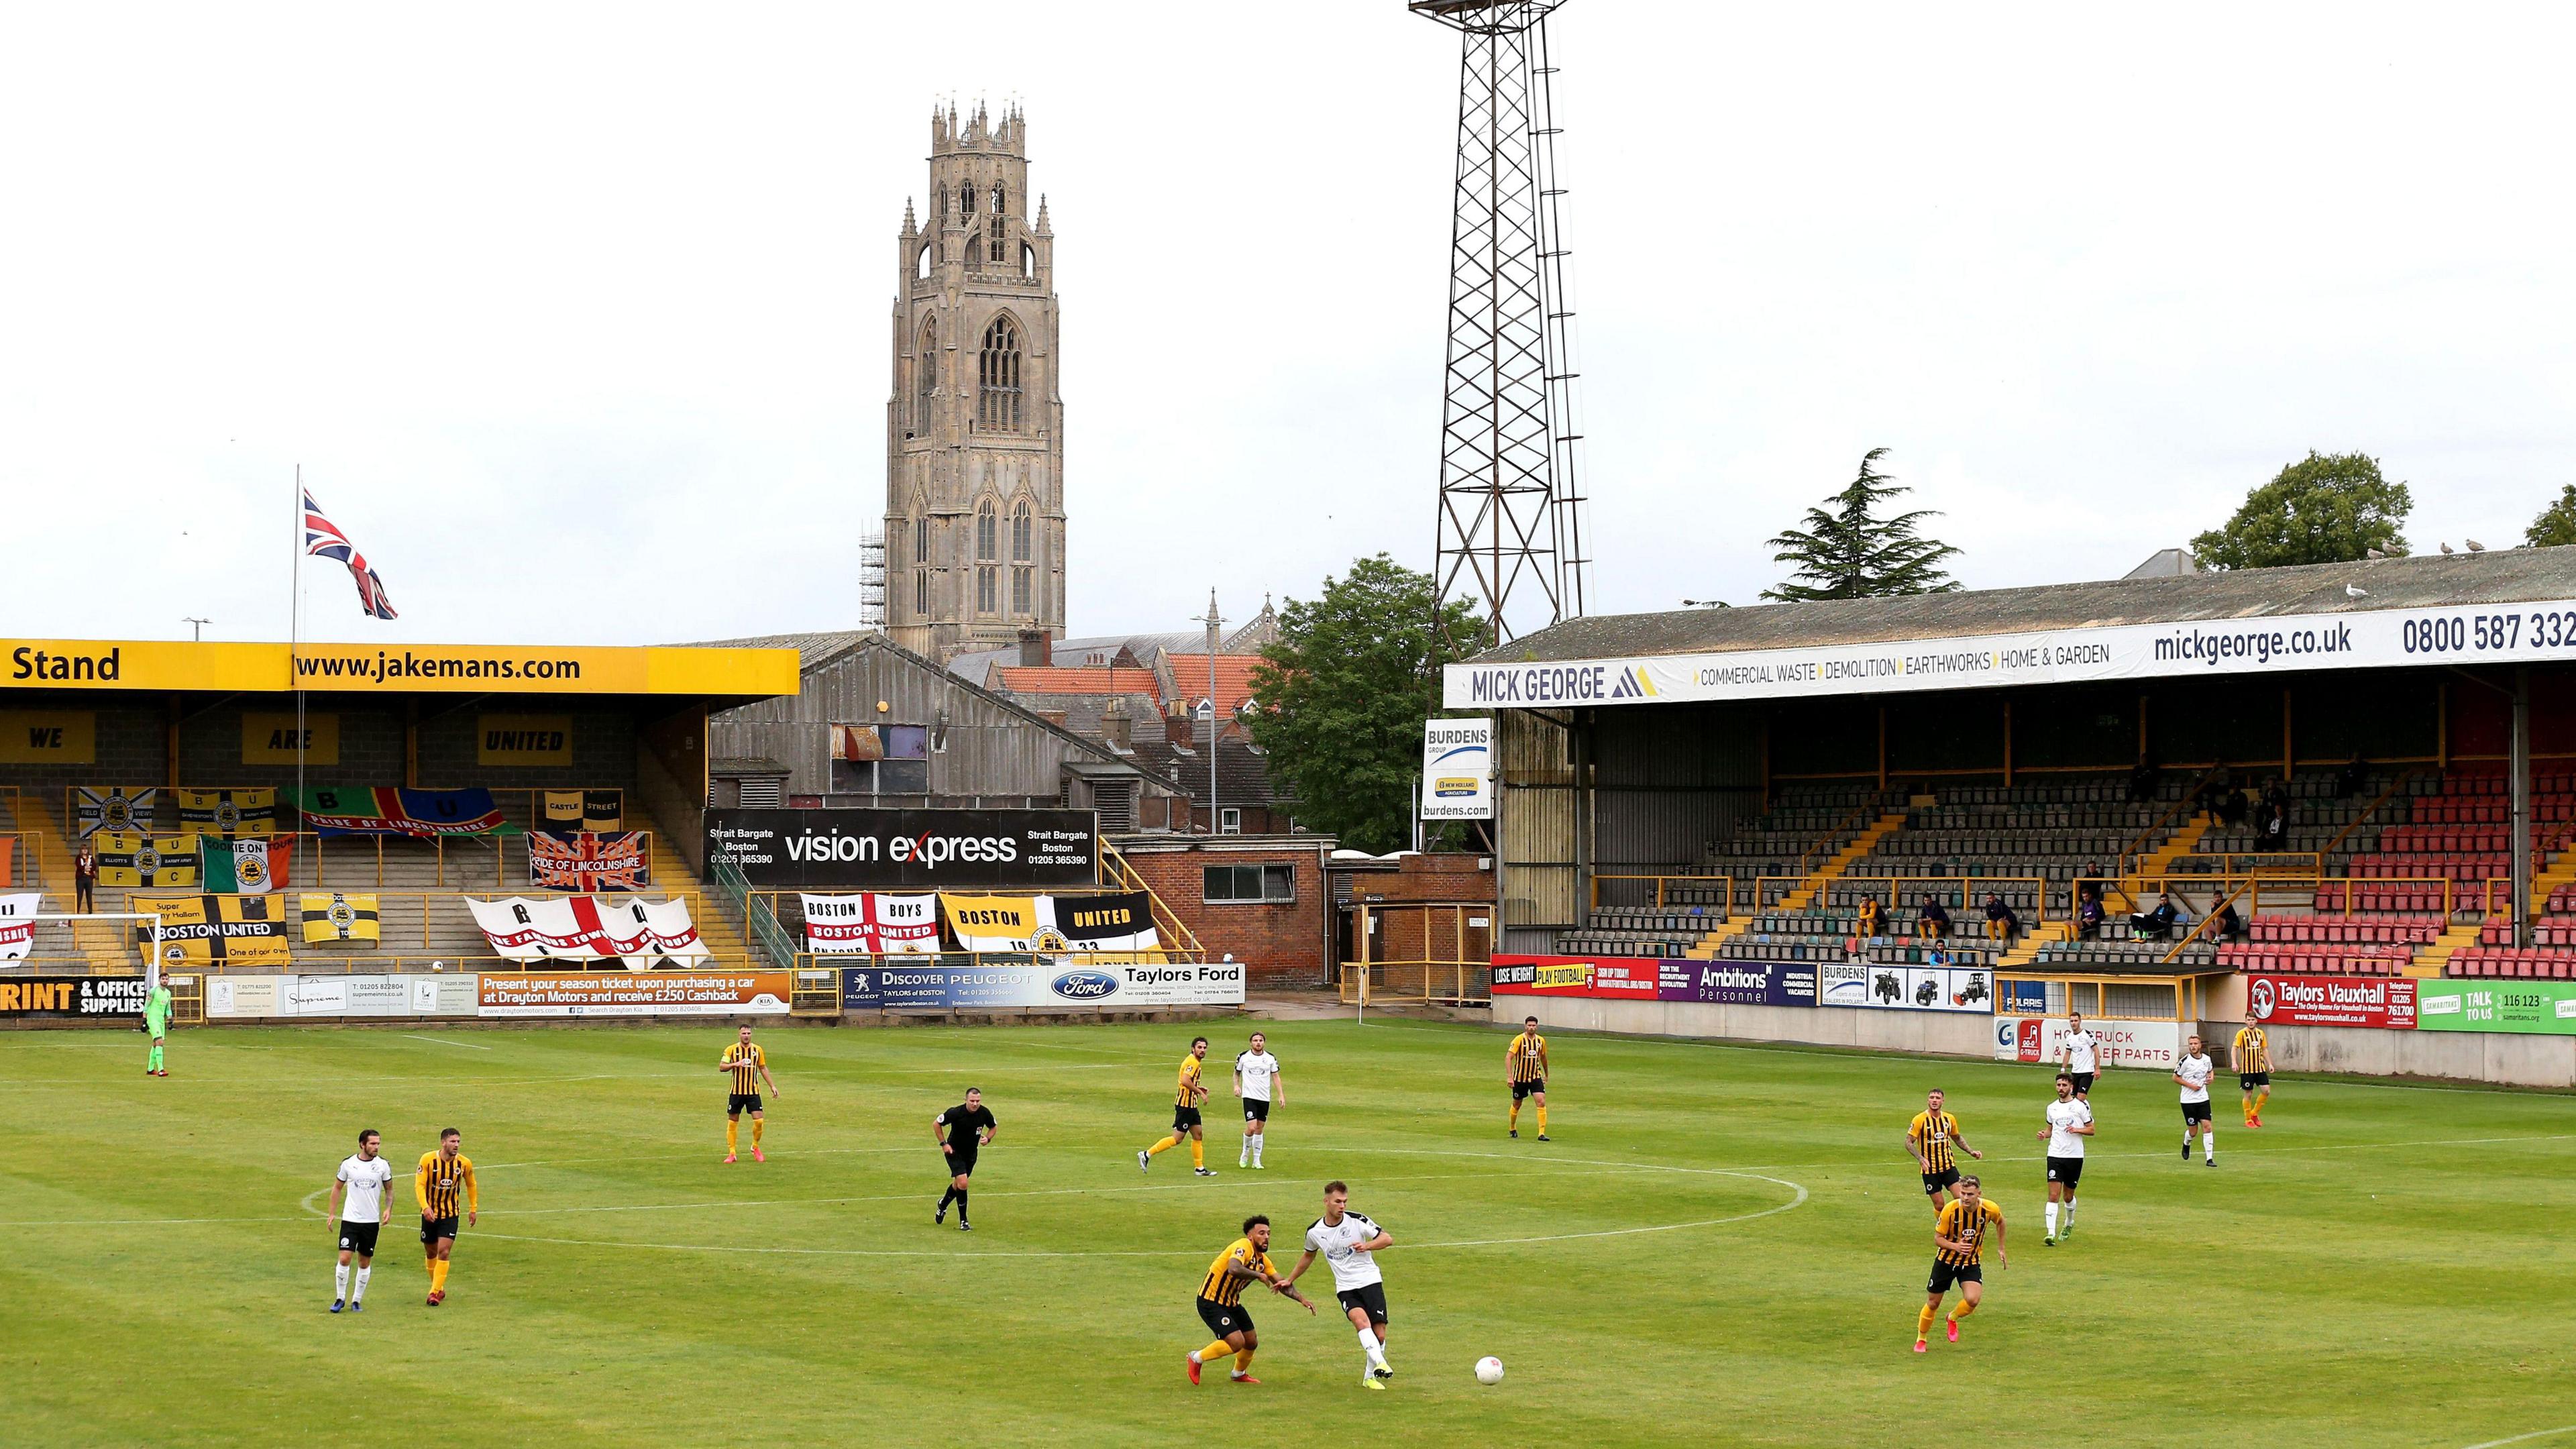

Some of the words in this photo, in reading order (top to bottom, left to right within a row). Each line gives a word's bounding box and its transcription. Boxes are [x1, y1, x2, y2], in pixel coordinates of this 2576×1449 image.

[2404, 616, 2465, 653] 0800
[2475, 614, 2520, 650] 587
[2155, 621, 2351, 665] mickgeorge.co.uk
[12, 647, 119, 681] Stand
[296, 651, 580, 683] www.jakemans.com
[1701, 665, 1774, 686] COMMERCIAL
[1776, 663, 1816, 682] WASTE
[1825, 657, 1896, 680] DEMOLITION
[1906, 651, 1991, 675] EARTHWORKS
[2001, 649, 2037, 669] HOME
[2042, 647, 2051, 665] &
[2056, 644, 2110, 665] GARDEN
[1472, 670, 1520, 701] MICK
[1525, 667, 1605, 701] GEORGE
[30, 728, 63, 748] WE
[268, 729, 312, 749] ARE
[486, 731, 564, 751] UNITED
[1428, 730, 1487, 744] BURDENS
[316, 792, 339, 809] B
[549, 802, 578, 810] CASTLE
[587, 802, 617, 810] STREET
[1424, 805, 1488, 815] burdens.com
[310, 814, 352, 826] PRIDE
[362, 819, 378, 828] OF
[388, 820, 488, 833] LINCOLNSHIRE
[738, 829, 773, 840] Bargate
[1028, 830, 1052, 839] Strait
[1053, 830, 1088, 841] Bargate
[115, 841, 123, 849] B
[205, 839, 246, 854] COOKIE
[248, 843, 263, 853] ON
[267, 838, 294, 852] TOUR
[534, 836, 637, 861] BOSTON
[726, 842, 758, 851] Boston
[785, 828, 878, 861] vision
[890, 830, 1017, 869] express
[1042, 843, 1073, 853] Boston
[556, 859, 571, 870] OF
[572, 857, 640, 871] LINCOLNSHIRE
[1028, 855, 1053, 865] 01205
[1055, 855, 1087, 865] 365390
[541, 868, 636, 887] UNITED
[156, 903, 180, 911] Super
[512, 904, 531, 924] B
[808, 902, 856, 916] BOSTON
[890, 904, 922, 918] BOYS
[958, 910, 1021, 926] BOSTON
[1074, 908, 1131, 927] UNITED
[159, 924, 220, 939] BOSTON
[223, 922, 271, 936] UNITED
[813, 924, 873, 938] BOSTON
[878, 926, 931, 937] UNITED
[1032, 927, 1048, 948] BOSTON
[1051, 928, 1071, 948] UNITED
[248, 948, 256, 956] of
[882, 972, 945, 985] DISCOVER
[950, 974, 1034, 985] PEUGEOT
[1125, 968, 1192, 984] Taylors
[1198, 967, 1239, 981] Ford
[1495, 968, 1514, 983] LOSE
[1515, 966, 1535, 982] WEIGHT
[1538, 970, 1553, 984] PLAY
[1554, 967, 1585, 983] FOOTBALL
[1597, 967, 1607, 977] SIGN
[1607, 968, 1613, 977] UP
[1614, 968, 1629, 978] TODAY!
[1701, 967, 1766, 989] Ambitions
[1824, 966, 1865, 979] BURDENS
[80, 981, 93, 997] &
[97, 981, 145, 997] OFFICE
[484, 978, 529, 989] Present
[531, 979, 557, 991] your
[559, 980, 599, 989] season
[600, 978, 633, 989] ticket
[636, 979, 663, 990] upon
[666, 977, 726, 991] purchasing
[729, 979, 735, 988] a
[737, 979, 755, 988] car
[1064, 974, 1106, 996] Ford
[2389, 982, 2413, 991] Telephone
[289, 993, 342, 1005] Supreme
[484, 993, 496, 1003] at
[498, 991, 545, 1005] Drayton
[547, 991, 588, 1002] Motors
[590, 991, 612, 1002] and
[614, 990, 653, 1002] receive
[655, 989, 685, 1001] £250
[687, 989, 739, 1001] Cashback
[1700, 989, 1766, 1002] Personnel
[2279, 981, 2324, 1005] Taylors
[2328, 983, 2385, 1004] Vauxhall
[2392, 994, 2410, 1003] 01205
[2466, 991, 2492, 1007] TALK
[80, 998, 144, 1013] SUPPLIES
[2307, 1004, 2318, 1012] Only
[2426, 1001, 2457, 1010] SAMARITANS
[2504, 995, 2520, 1006] 116
[2523, 995, 2539, 1007] 123
[2294, 1012, 2366, 1022] www.taylorsvauxhall.co.uk
[2387, 1006, 2414, 1016] 761700
[2467, 1009, 2479, 1021] TO
[2481, 1008, 2492, 1020] US
[2503, 1014, 2540, 1022] samaritans.org
[2054, 1046, 2061, 1056] &
[2125, 1049, 2170, 1061] PARTS
